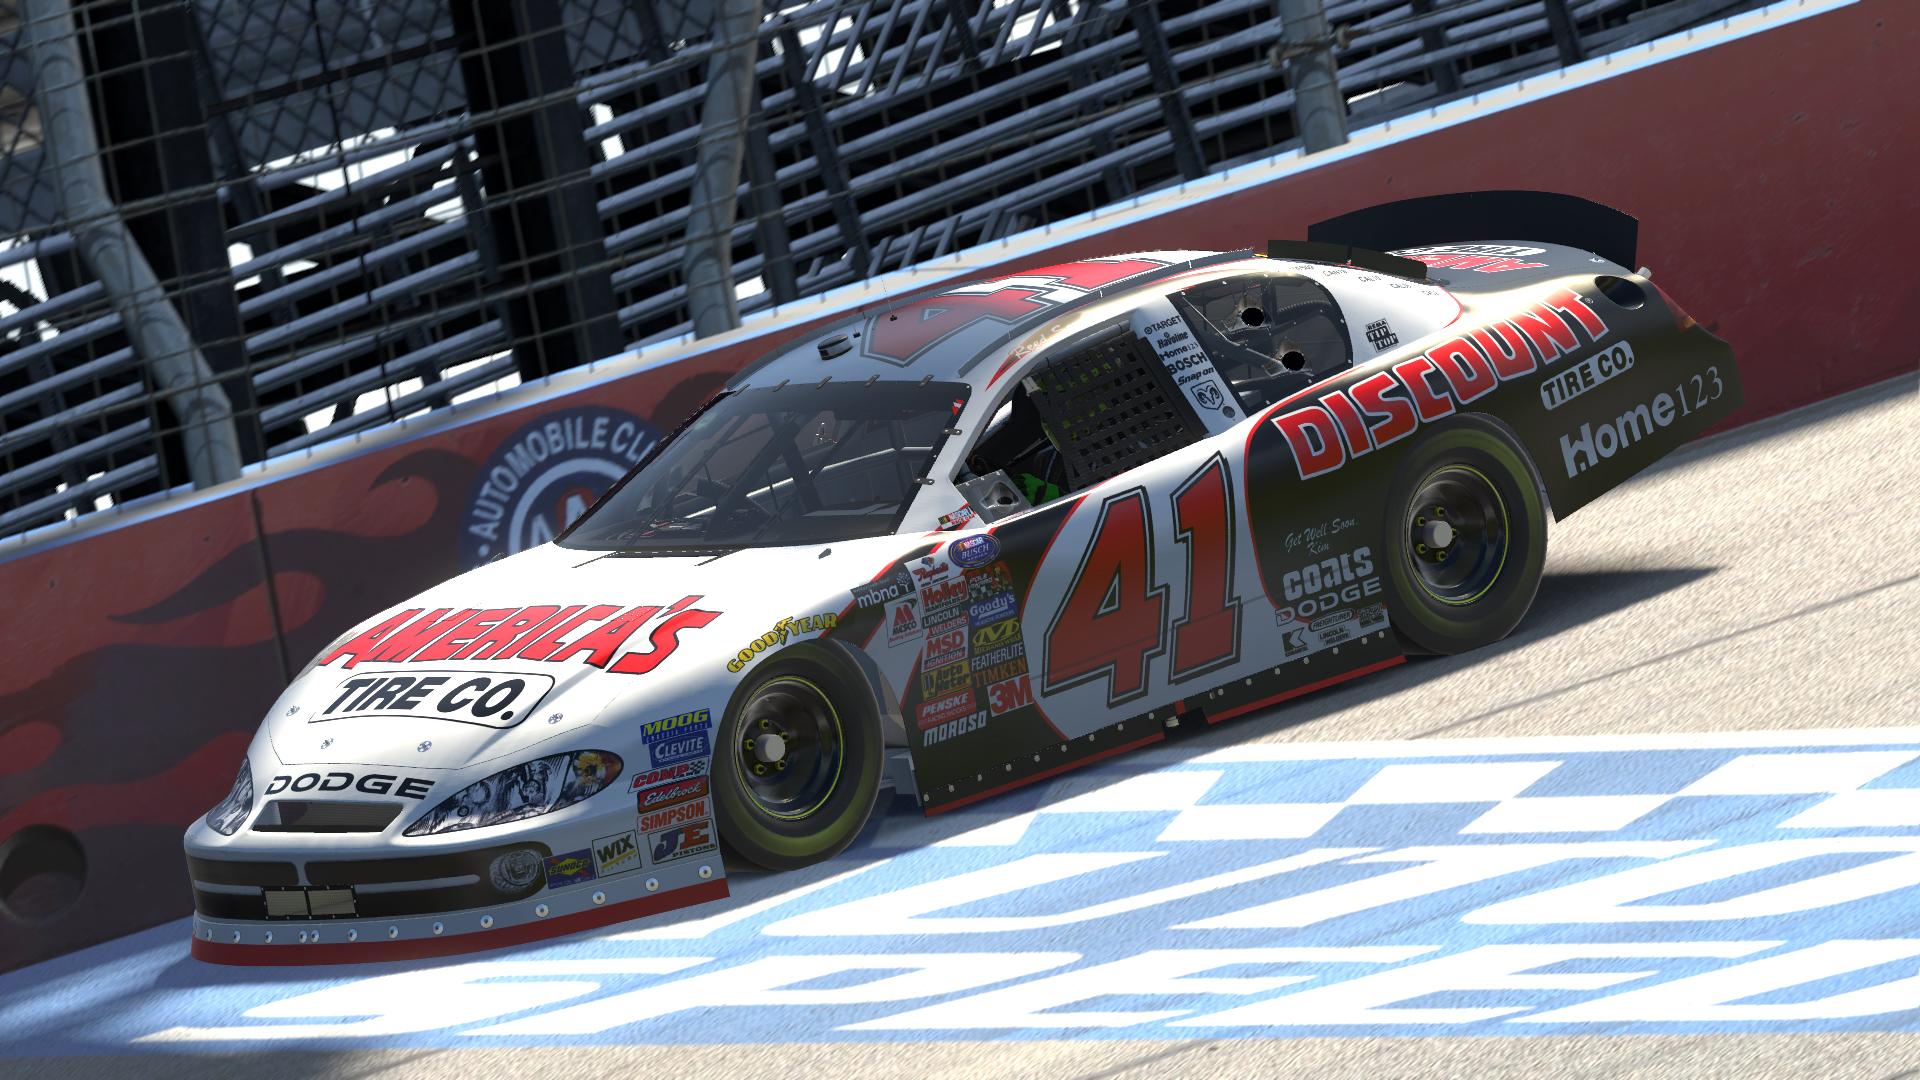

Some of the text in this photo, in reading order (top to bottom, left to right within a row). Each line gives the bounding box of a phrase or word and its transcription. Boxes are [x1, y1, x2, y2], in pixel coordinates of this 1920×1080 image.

[1151, 315, 1182, 332] TARGET
[1366, 327, 1391, 343] TIP
[1157, 331, 1190, 349] Havoline
[1374, 334, 1399, 351] TOP
[1166, 351, 1209, 376] BOSCH
[1544, 346, 1634, 407] TIRE CO.
[1271, 288, 1610, 481] DISCOUNT
[468, 415, 611, 542] AUTOMOBILE
[1284, 532, 1302, 553] Get
[1303, 522, 1328, 541] Well
[1040, 450, 1244, 709] 41
[857, 583, 900, 609] mbna
[970, 592, 1015, 616] Goody's
[1275, 576, 1382, 627] DODGE
[923, 606, 960, 627] LINCOLN
[927, 630, 965, 660] MSD
[970, 642, 1024, 673] FEATHERLITE
[974, 656, 1028, 689] TIMKEN
[322, 676, 526, 721] TIRE CO.
[989, 674, 1033, 715] 3M
[643, 709, 709, 737] MOOG
[923, 709, 988, 748] MOROSO
[655, 736, 705, 760] CLEVITE
[263, 771, 436, 800] DODGE
[641, 800, 705, 832] SIMPSON
[597, 833, 634, 863] WIX
[653, 820, 710, 862] JE
